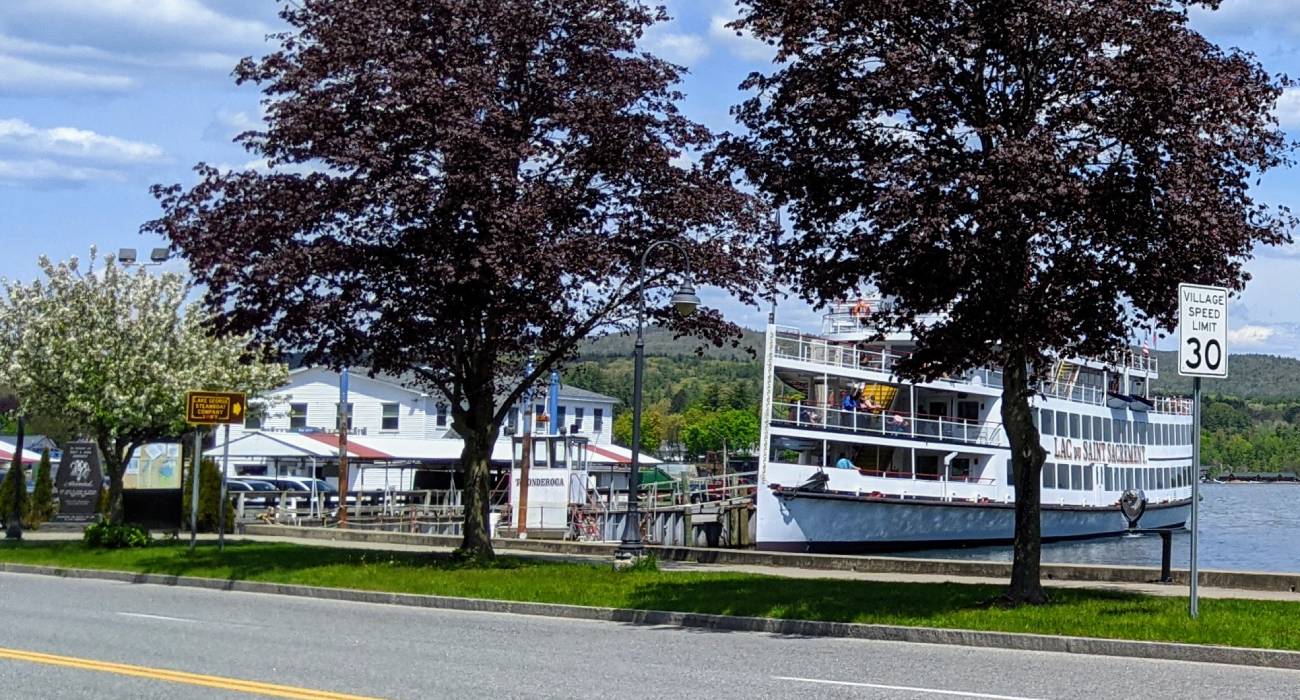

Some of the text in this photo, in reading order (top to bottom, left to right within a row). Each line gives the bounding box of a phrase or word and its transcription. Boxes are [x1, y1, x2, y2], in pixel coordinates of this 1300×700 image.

[1183, 290, 1224, 306] VILLAGE
[1188, 306, 1220, 319] SPEED
[1192, 320, 1217, 333] LIMIT
[1185, 337, 1221, 370] 30
[1054, 437, 1072, 460] LAC
[1082, 441, 1106, 462] SAINT
[515, 478, 565, 487] TONDEROGA
